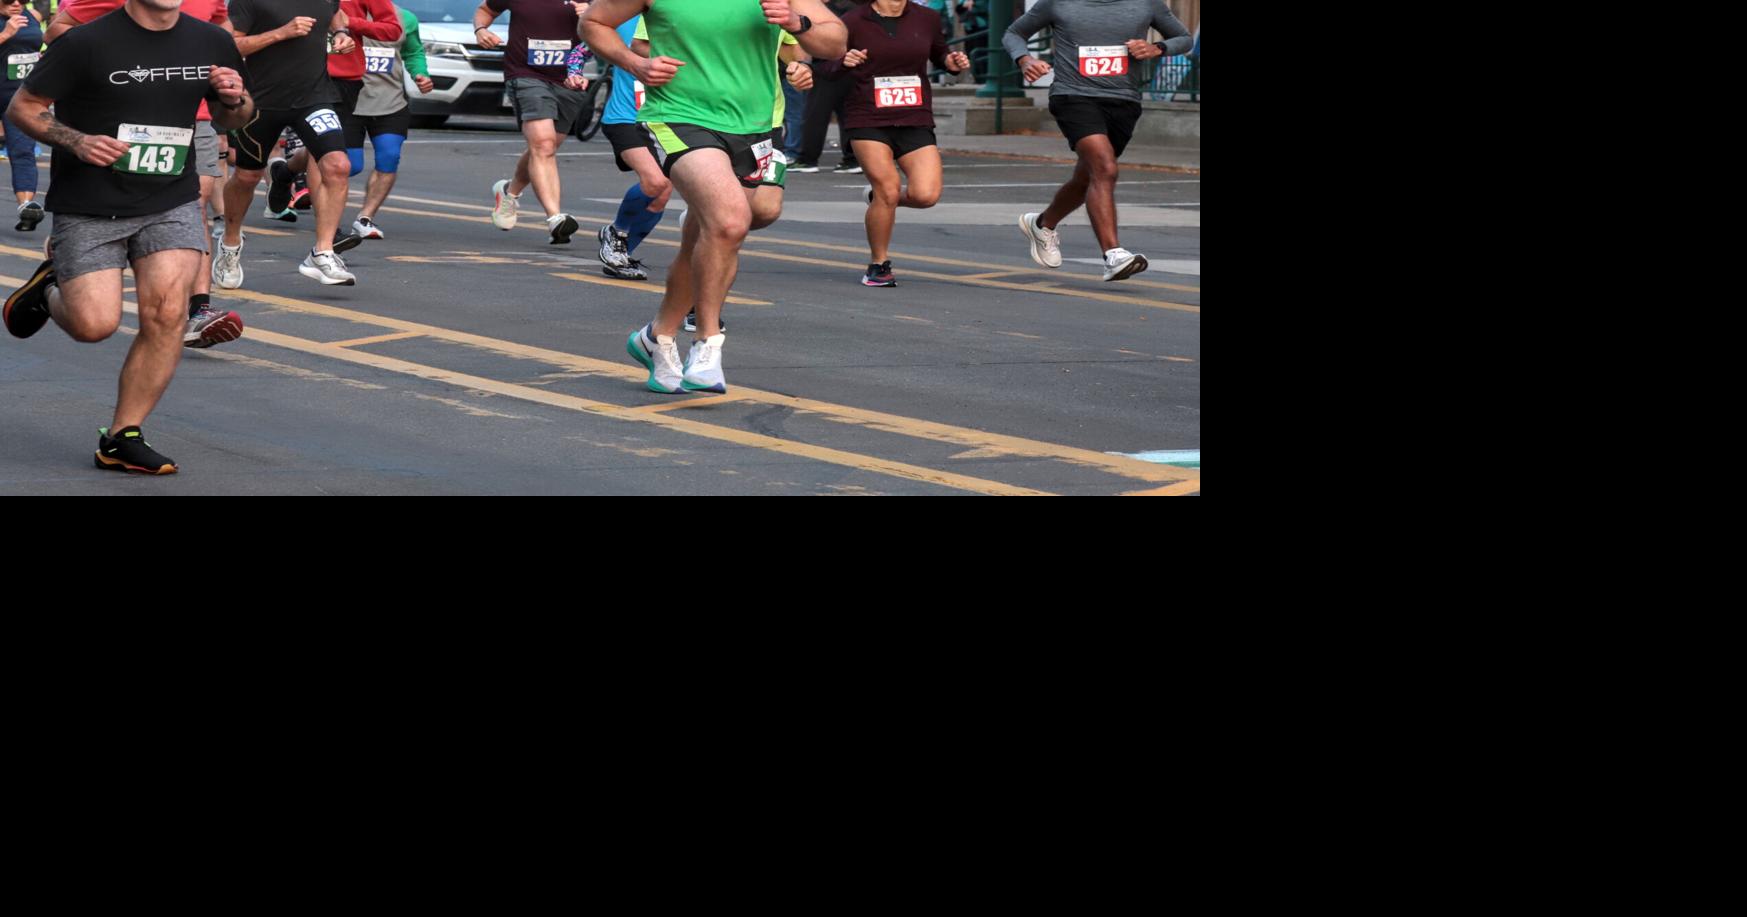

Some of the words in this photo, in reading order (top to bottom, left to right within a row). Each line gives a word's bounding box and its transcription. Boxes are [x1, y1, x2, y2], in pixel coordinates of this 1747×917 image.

[533, 50, 565, 65] 372
[1085, 57, 1123, 75] 624
[880, 88, 917, 106] 625
[128, 144, 176, 174] 143
